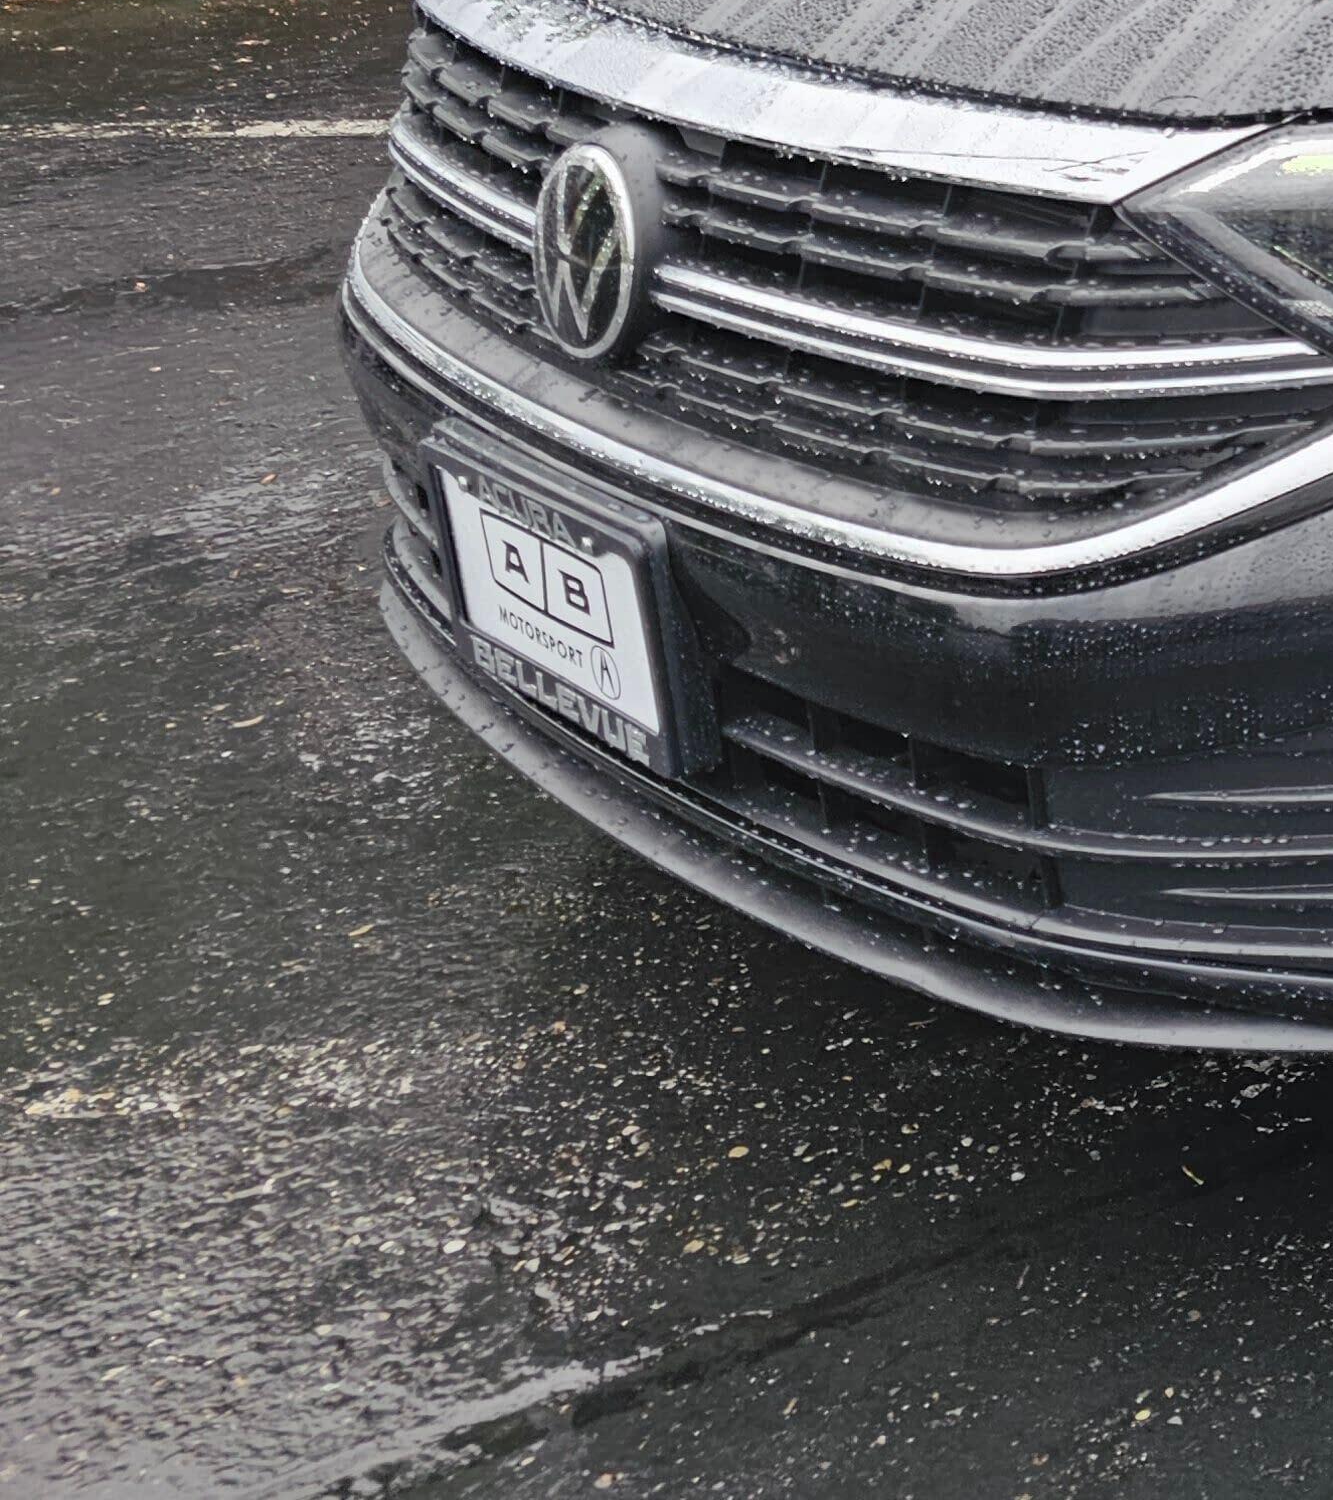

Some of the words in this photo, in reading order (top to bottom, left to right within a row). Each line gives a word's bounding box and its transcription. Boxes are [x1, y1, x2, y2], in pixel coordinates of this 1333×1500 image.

[478, 475, 578, 550] ACURA
[502, 539, 531, 585] A
[558, 568, 591, 616] B
[498, 604, 583, 669] MOTORSPORT
[471, 635, 650, 767] BELLEVUE
